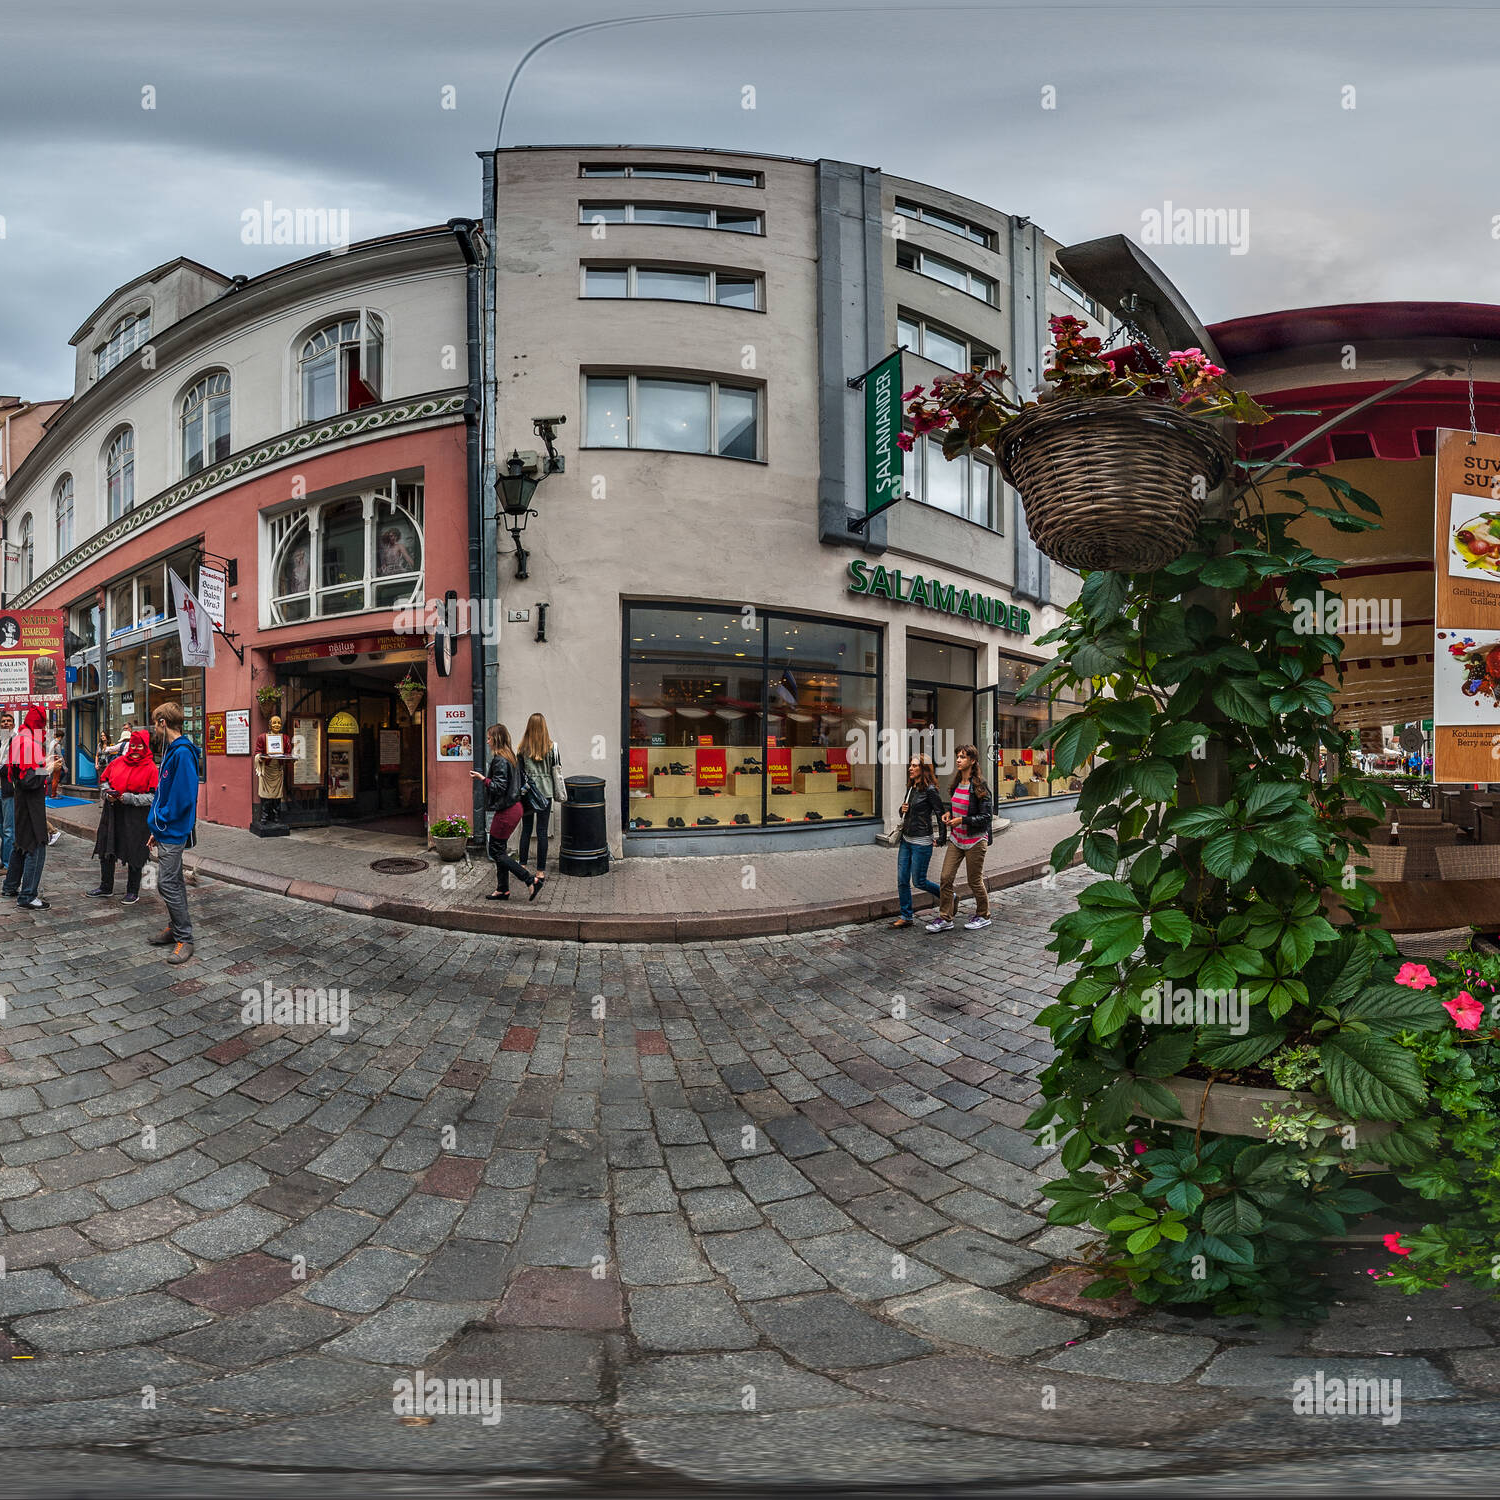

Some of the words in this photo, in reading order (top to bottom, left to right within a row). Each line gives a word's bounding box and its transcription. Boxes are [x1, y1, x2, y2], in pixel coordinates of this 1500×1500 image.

[876, 369, 891, 494] SALAMANDER
[516, 611, 522, 619] 5
[849, 559, 1031, 635] SALAMANDER
[445, 711, 466, 719] KGB
